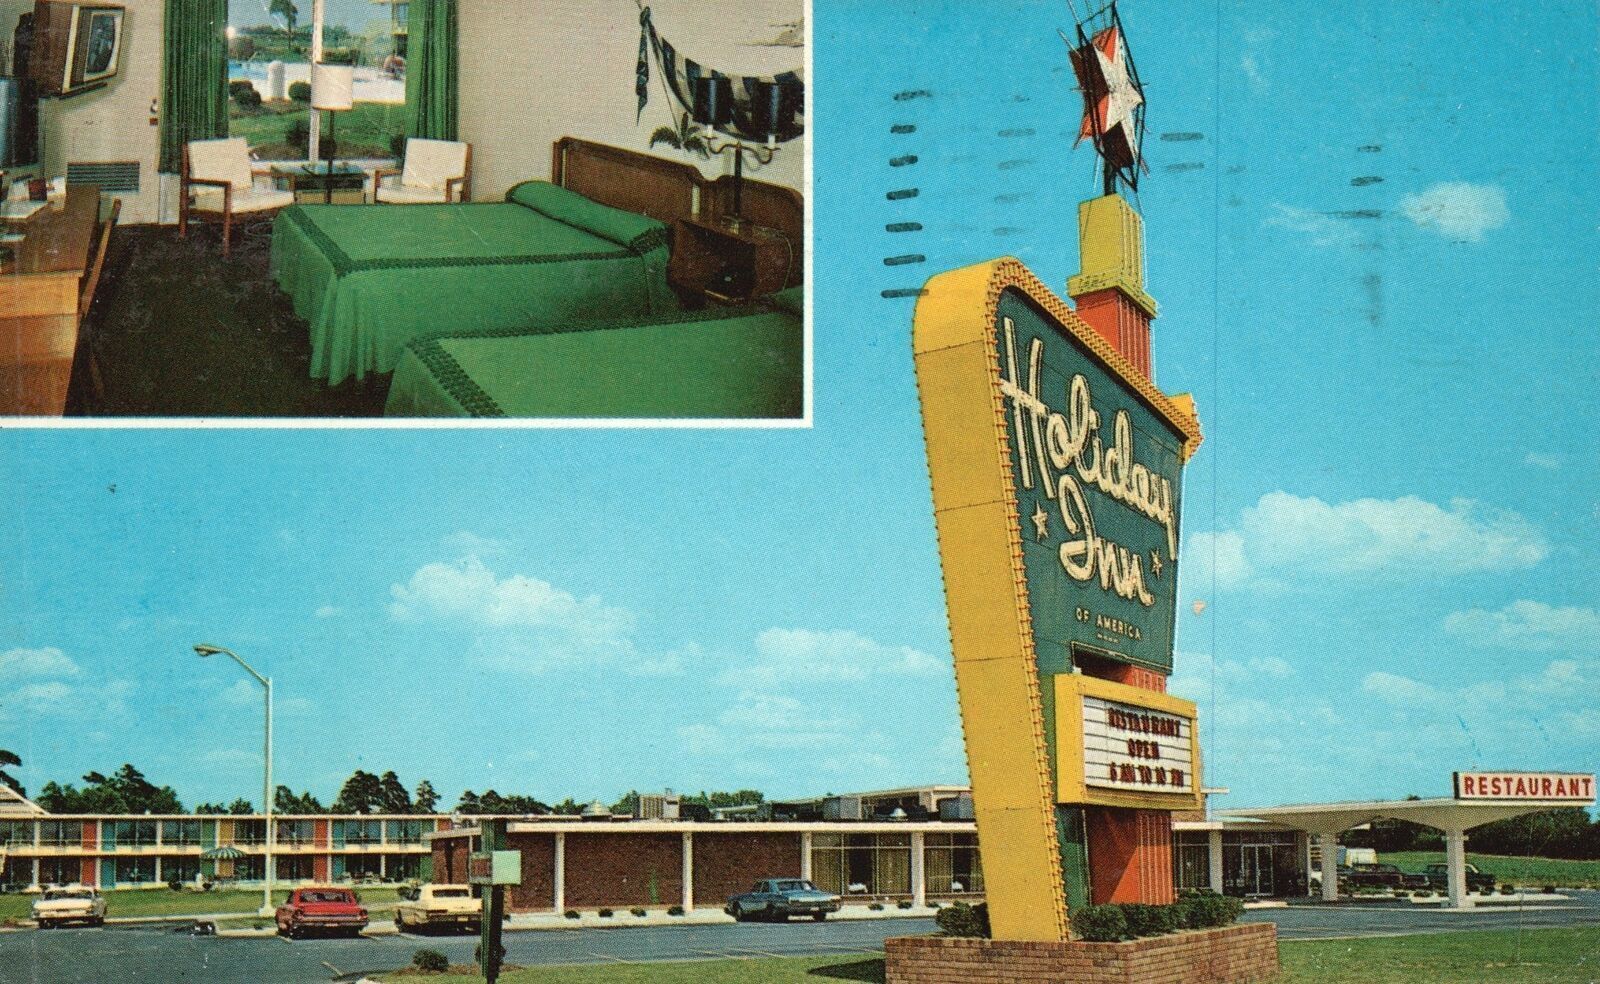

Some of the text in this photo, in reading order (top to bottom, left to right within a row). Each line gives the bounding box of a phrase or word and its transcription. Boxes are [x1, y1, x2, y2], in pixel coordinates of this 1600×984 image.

[1000, 317, 1177, 561] Holiday
[1058, 474, 1155, 607] Inn
[1075, 606, 1090, 621] OF
[1096, 614, 1142, 641] AMERICA
[1108, 707, 1182, 738] RESTAURANT
[1127, 738, 1160, 760] OPEN
[1463, 775, 1592, 797] RESTAURANT
